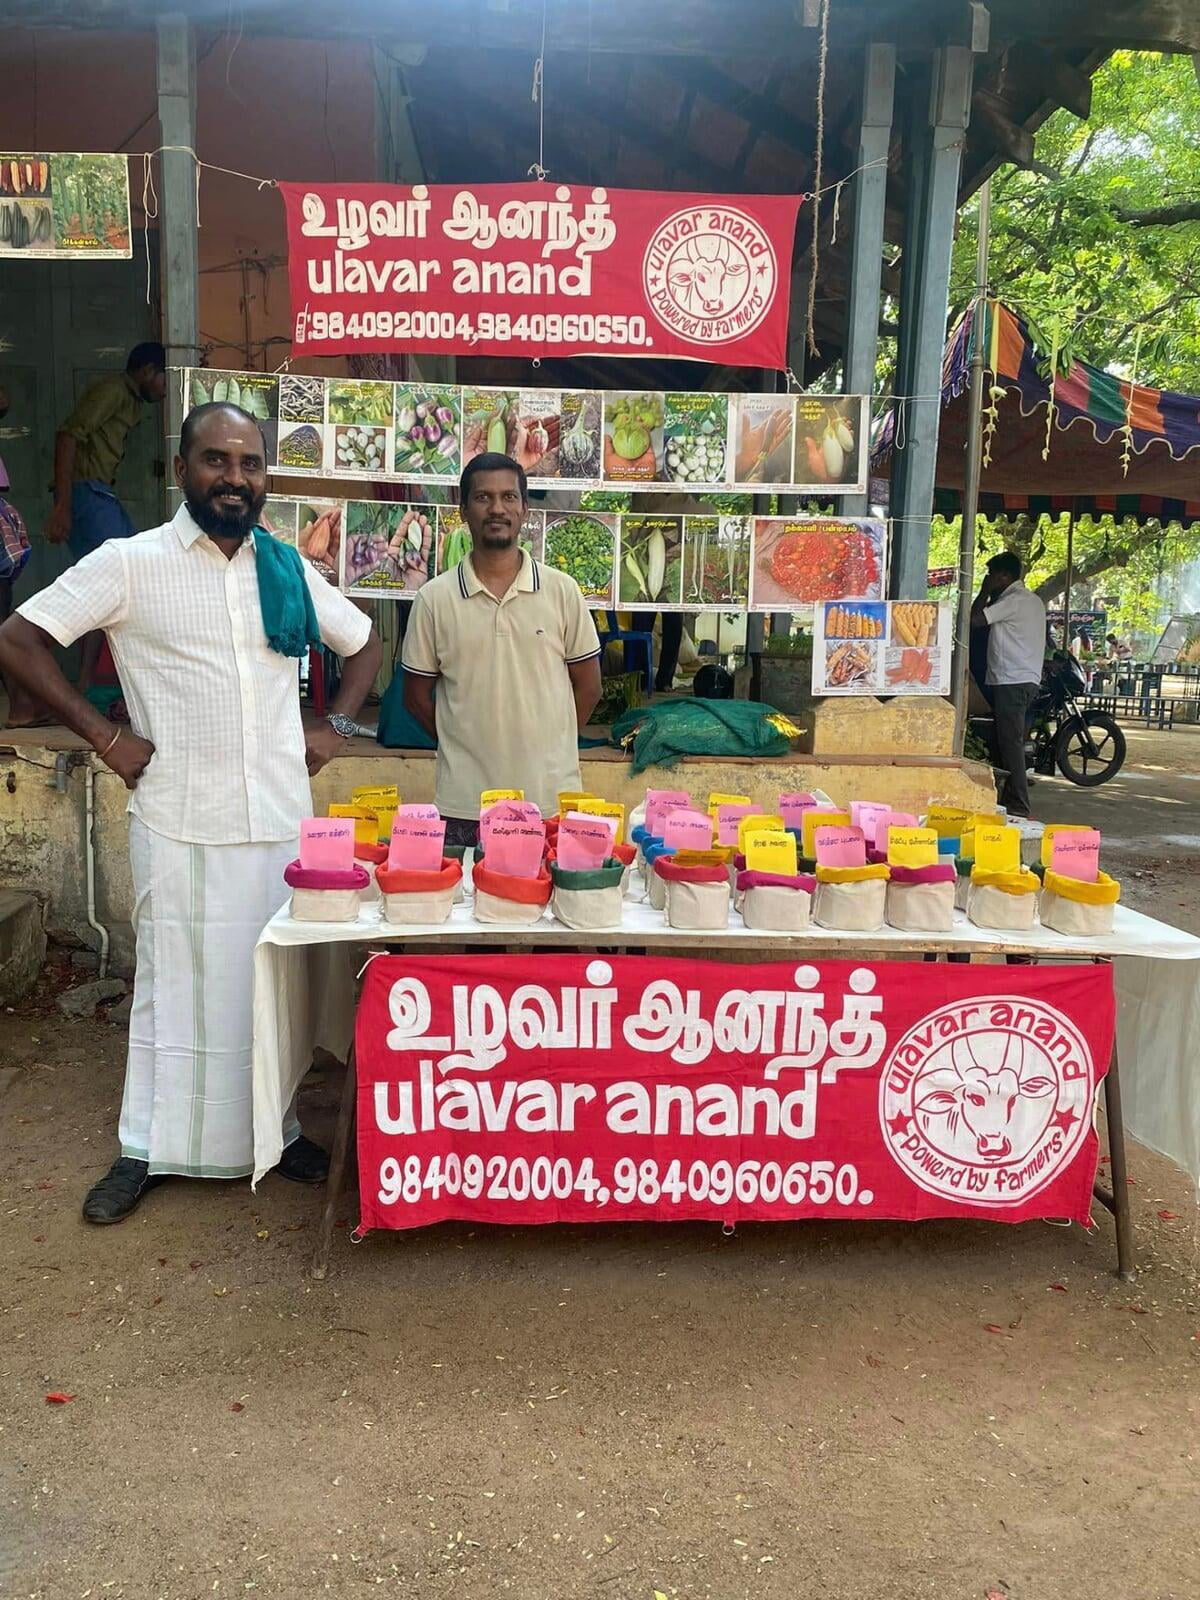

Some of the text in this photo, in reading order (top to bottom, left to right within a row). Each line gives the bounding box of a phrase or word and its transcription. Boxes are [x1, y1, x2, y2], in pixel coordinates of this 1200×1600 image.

[302, 186, 617, 258] உழவர் ஆனந்த்
[649, 212, 769, 271] ulavar anand
[308, 250, 592, 297] ulavar anand
[701, 321, 714, 338] by
[715, 286, 763, 337] farmers
[387, 960, 887, 1084] உழவர் ஆனந்த்
[888, 1003, 1087, 1094] ulavar anand
[374, 1061, 818, 1140] ulavar anand
[378, 1153, 875, 1208] 9840920004,9840960650.
[966, 1167, 989, 1192] by
[994, 1131, 1063, 1192] farmers
